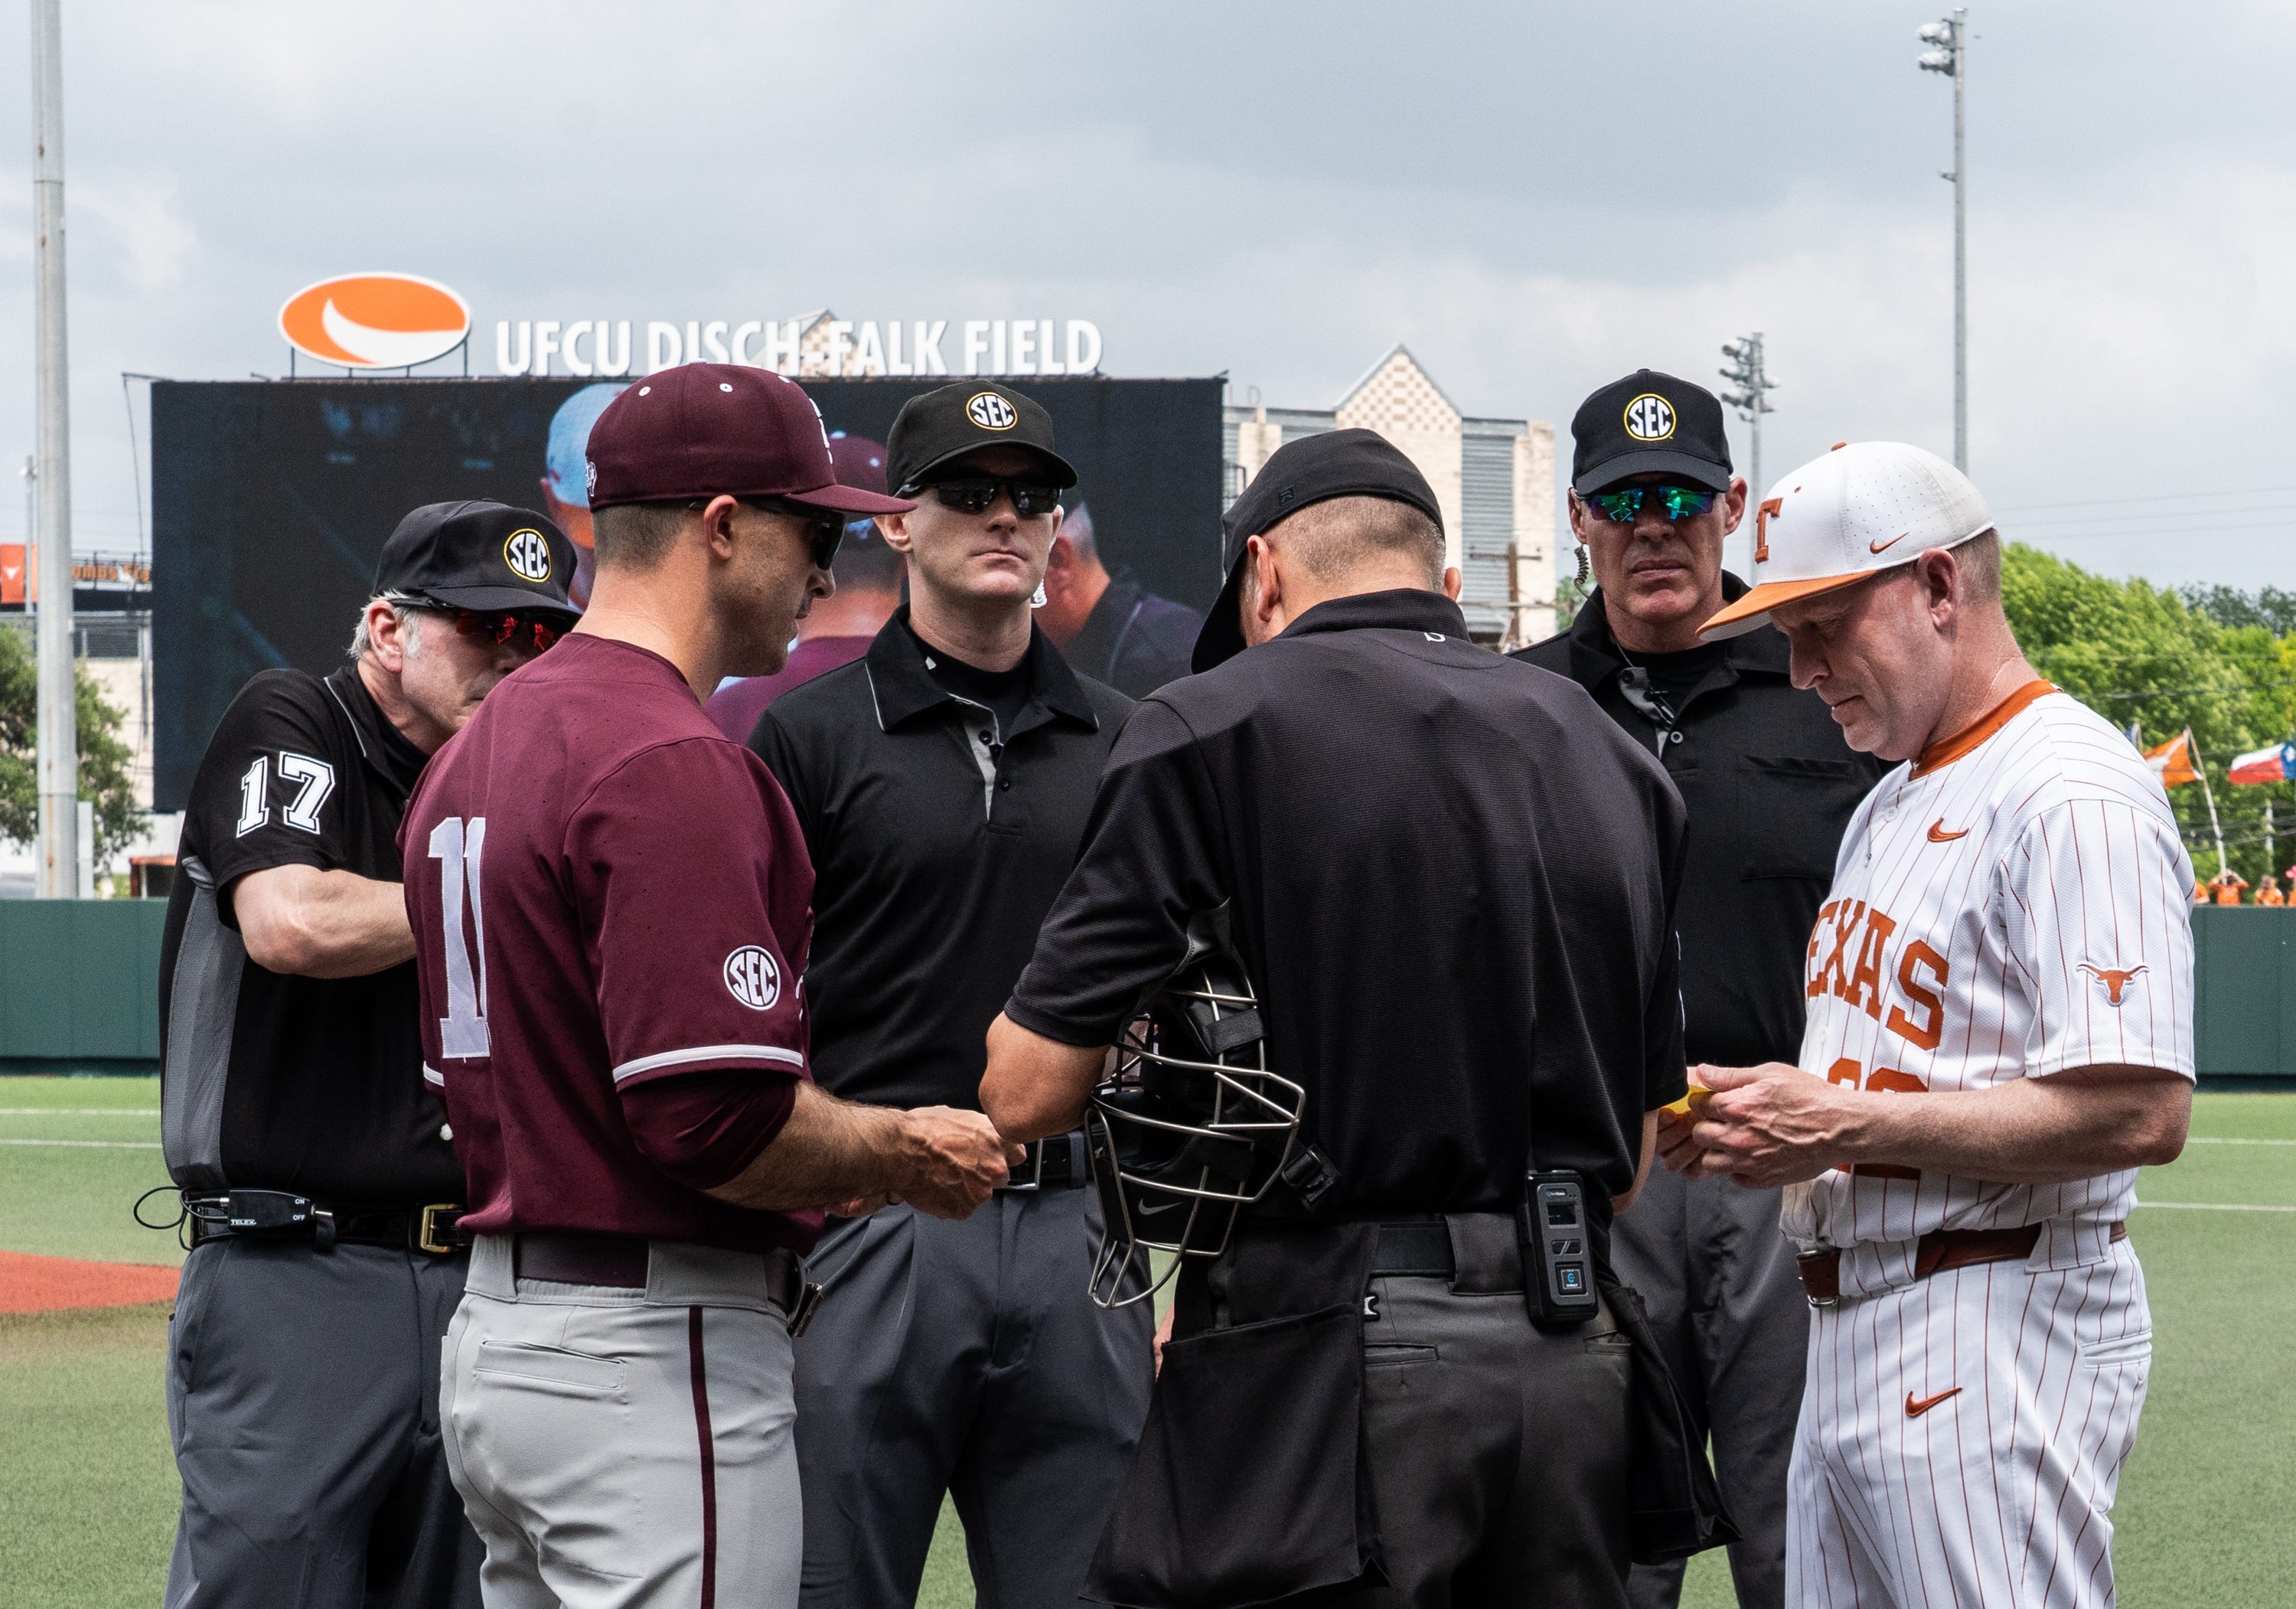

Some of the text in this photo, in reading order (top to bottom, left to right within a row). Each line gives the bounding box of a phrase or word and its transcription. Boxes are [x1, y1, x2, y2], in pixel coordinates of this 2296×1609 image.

[497, 319, 1103, 377] UFCU DISCH-FALK FIELD
[970, 395, 1014, 427] SEC
[1628, 397, 1671, 438] SEC
[509, 533, 548, 579] SEC
[236, 750, 335, 838] 17
[729, 951, 776, 1006] SEC
[1807, 897, 1950, 1051] EXAS
